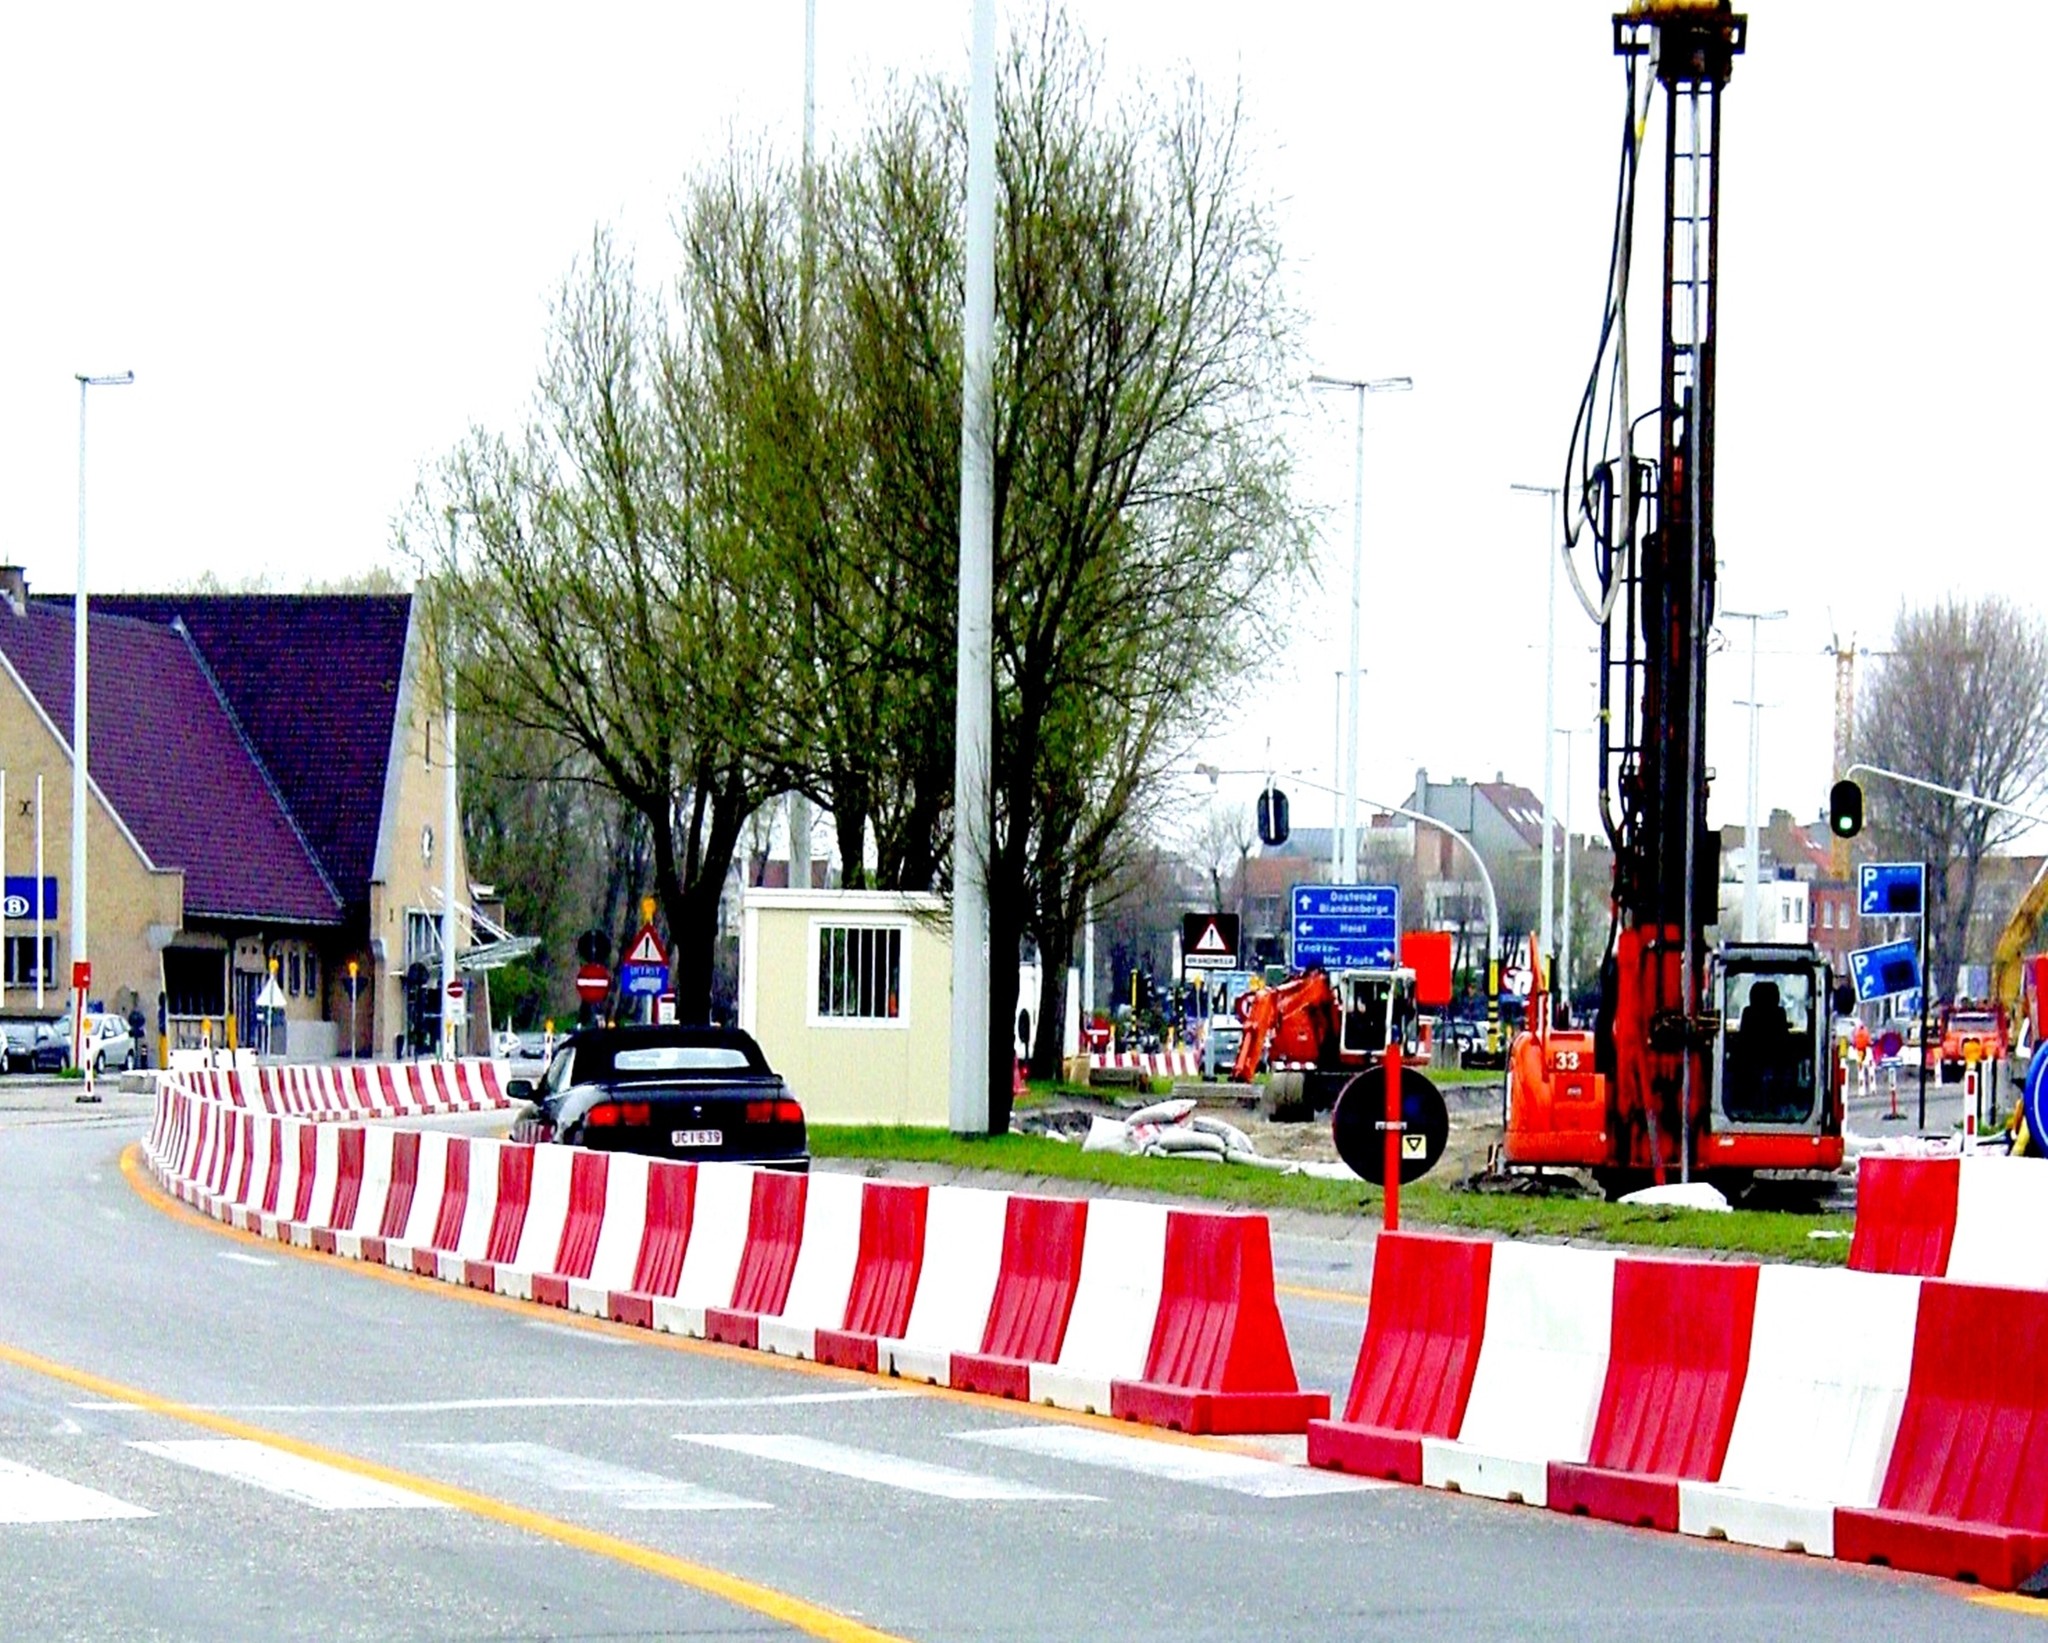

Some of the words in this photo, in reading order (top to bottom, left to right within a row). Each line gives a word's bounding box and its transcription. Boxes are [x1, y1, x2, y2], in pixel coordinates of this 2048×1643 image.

[1319, 903, 1389, 915] Blankenberge
[1339, 923, 1367, 933] Heist
[1323, 955, 1341, 965] Het
[1556, 1051, 1579, 1070] 33
